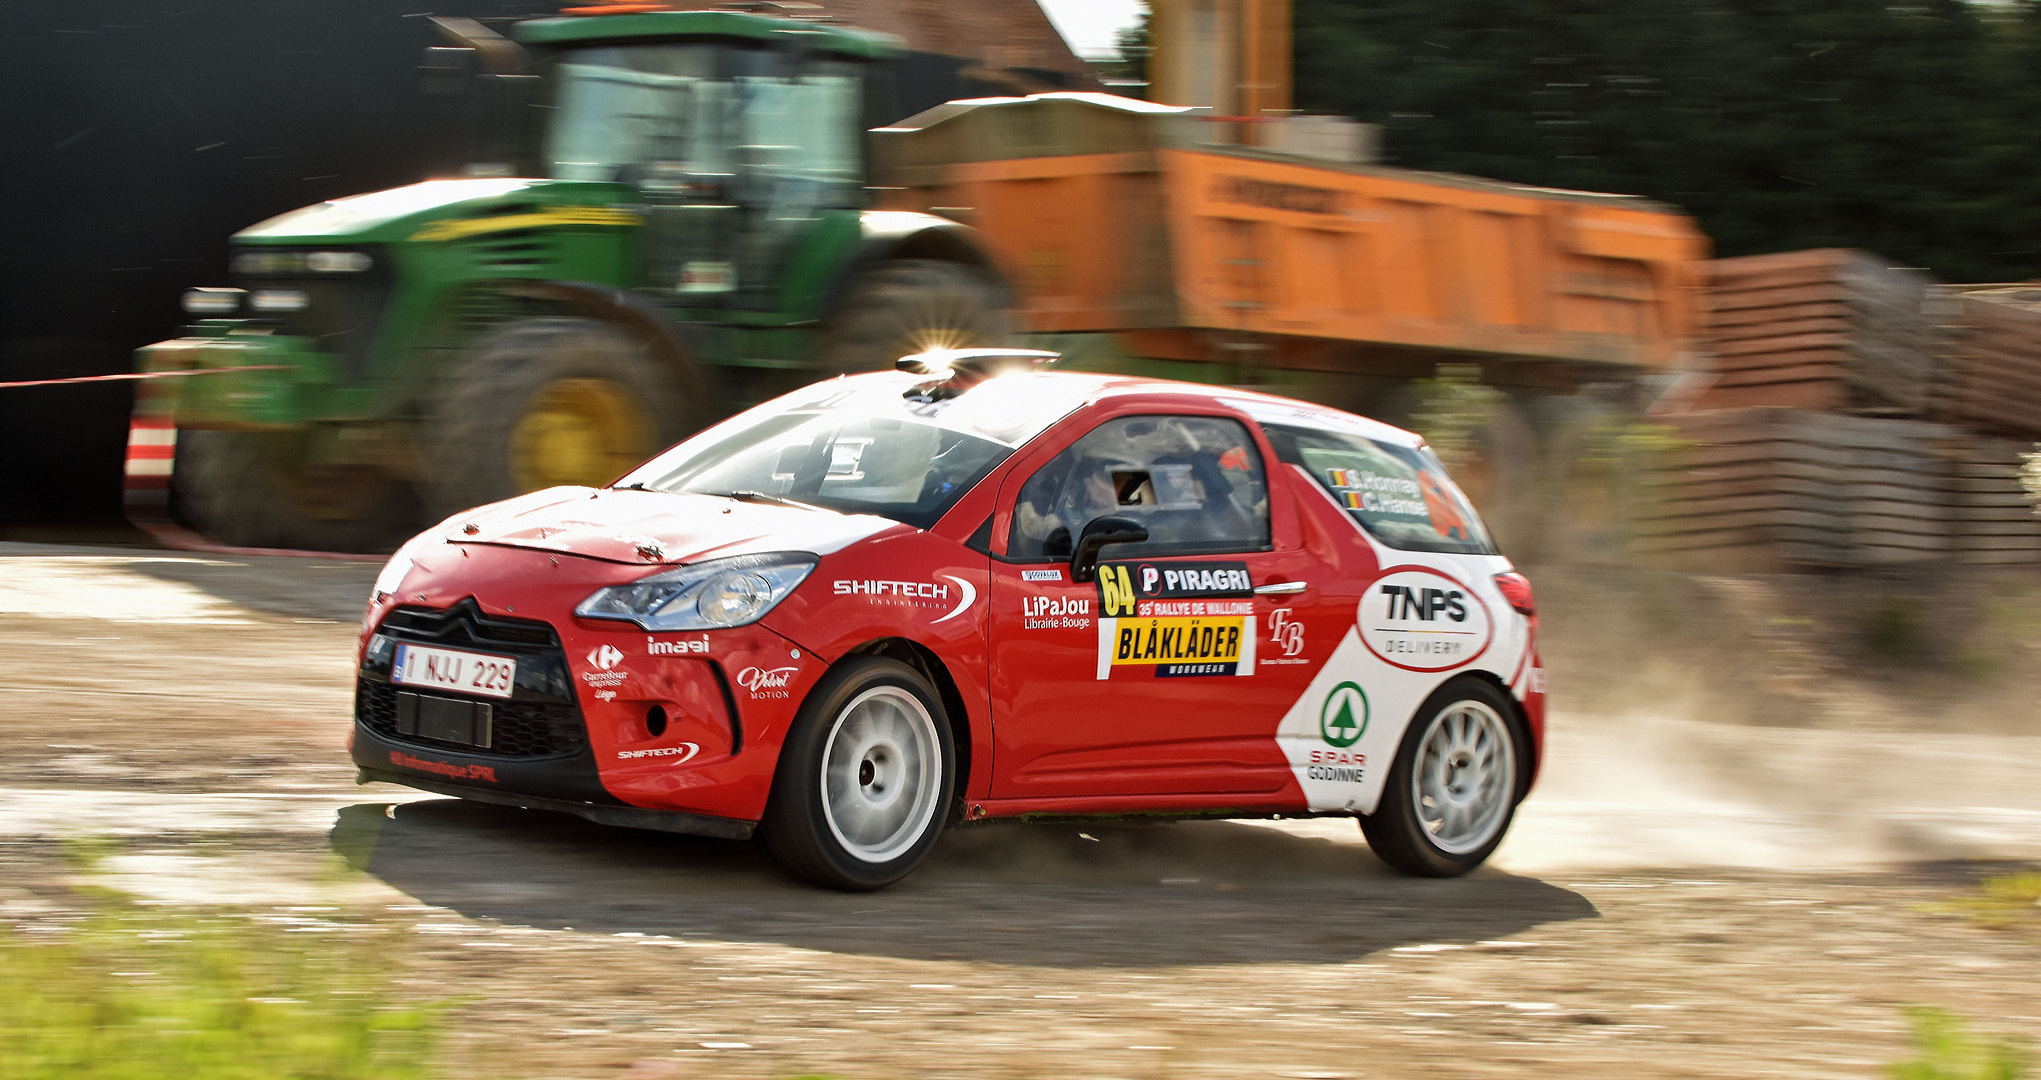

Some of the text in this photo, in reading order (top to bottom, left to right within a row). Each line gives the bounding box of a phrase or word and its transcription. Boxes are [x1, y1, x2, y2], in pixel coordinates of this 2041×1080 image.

[833, 579, 948, 600] SHIFTECH
[1098, 564, 1136, 617] 64
[1164, 569, 1251, 591] PIRAGRI
[1023, 596, 1090, 618] LiPaJou
[1154, 602, 1189, 616] RALLYE
[1191, 602, 1205, 615] DE
[1206, 602, 1254, 615] WALLONIE
[1380, 584, 1467, 623] TNPS
[1118, 619, 1239, 660] BLÅKLÄDER
[1386, 639, 1464, 655] DELIVERY
[407, 652, 416, 678] 1
[424, 654, 463, 684] NJJ
[472, 660, 511, 691] 229
[1169, 663, 1226, 675] WORKWEAR
[751, 691, 789, 700] MOTION
[618, 746, 684, 760] SHIFTECH
[1310, 750, 1366, 766] SPAR
